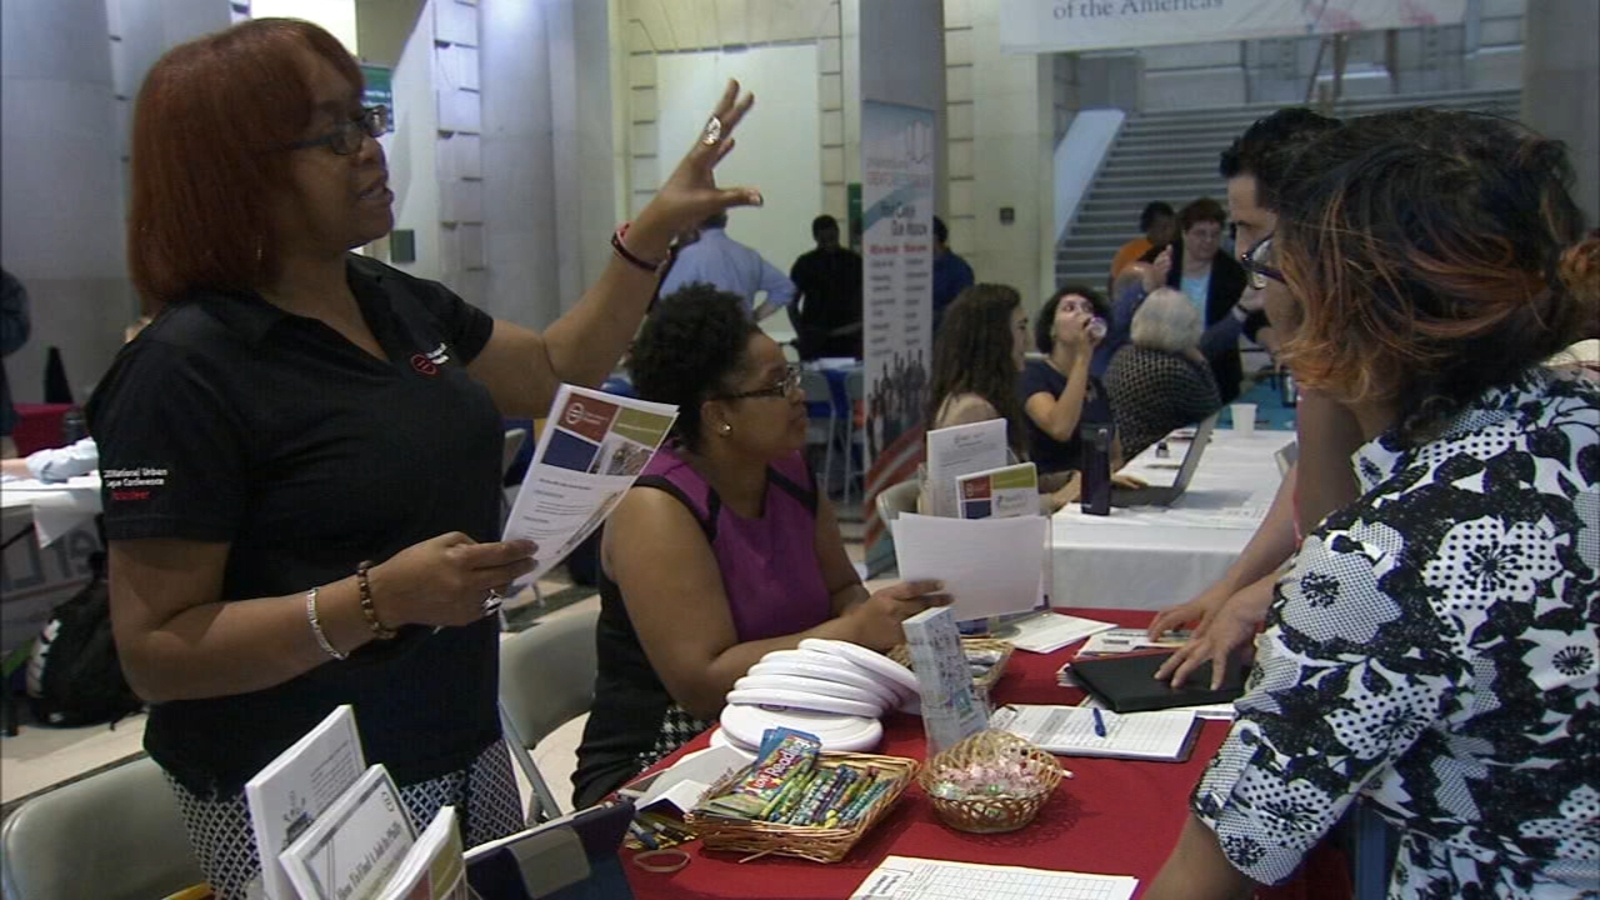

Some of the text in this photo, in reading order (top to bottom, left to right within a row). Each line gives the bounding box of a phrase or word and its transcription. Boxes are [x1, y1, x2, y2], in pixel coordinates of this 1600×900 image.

[1053, 0, 1223, 19] of the Americas
